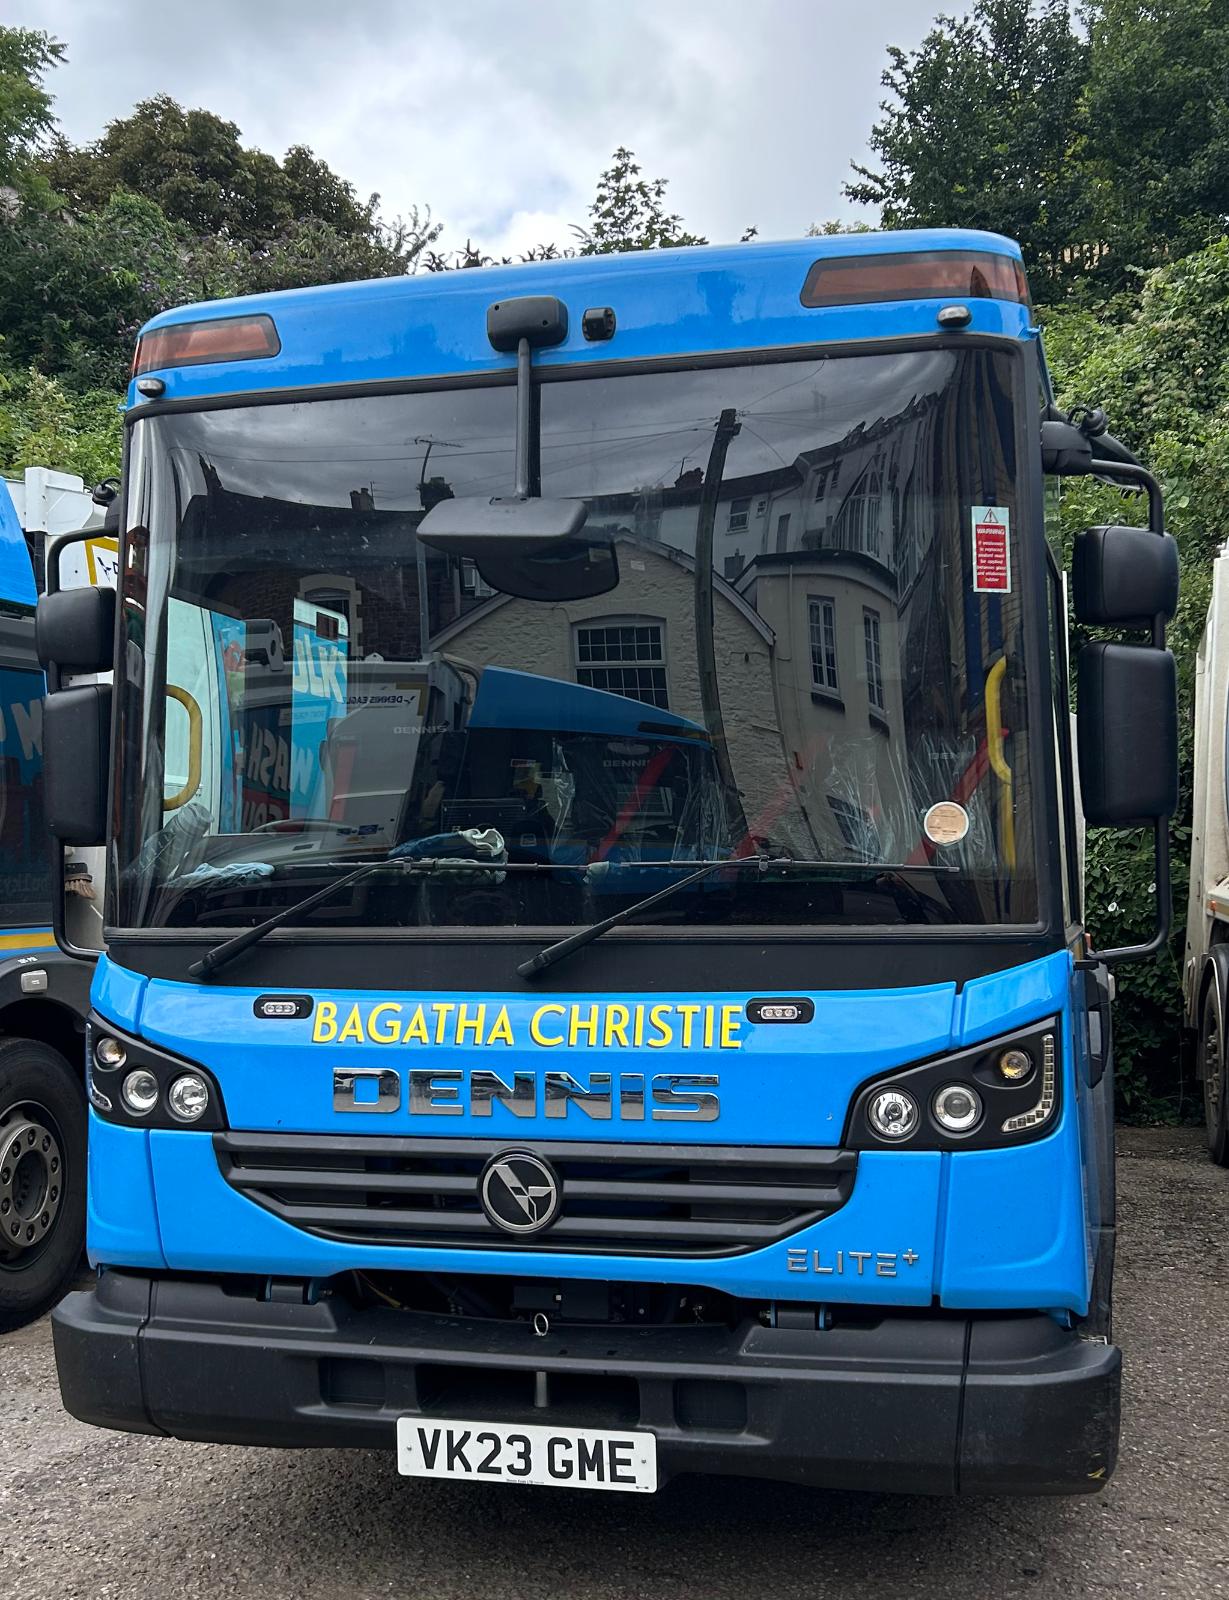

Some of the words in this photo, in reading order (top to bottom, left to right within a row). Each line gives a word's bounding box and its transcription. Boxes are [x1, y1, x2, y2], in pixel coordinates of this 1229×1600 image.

[312, 1001, 515, 1046] BAGATHA
[530, 1003, 744, 1049] CHRISTIE
[333, 1067, 720, 1122] DENNIS
[416, 1427, 532, 1477] VK23
[547, 1436, 637, 1484] GME
